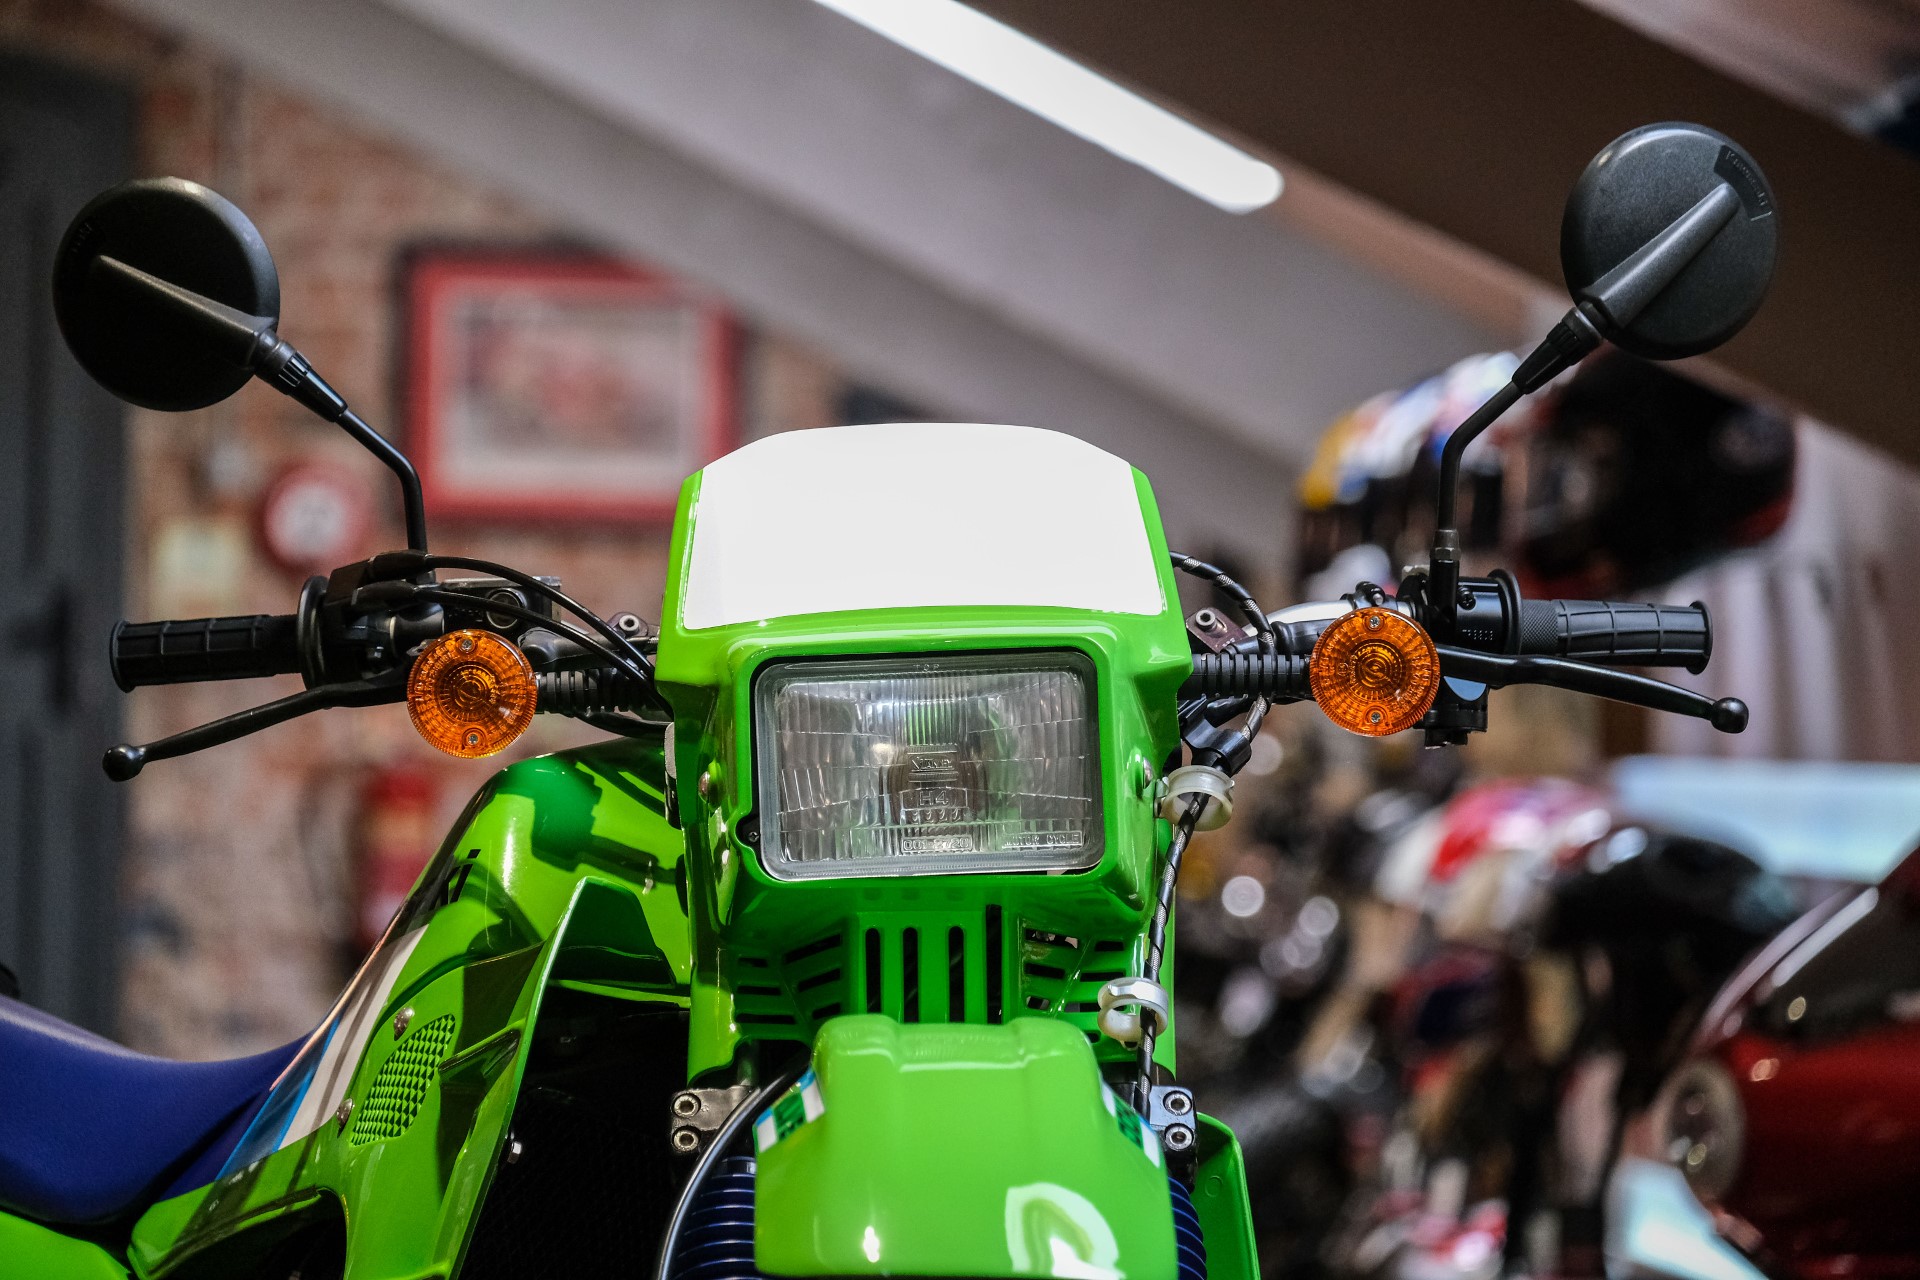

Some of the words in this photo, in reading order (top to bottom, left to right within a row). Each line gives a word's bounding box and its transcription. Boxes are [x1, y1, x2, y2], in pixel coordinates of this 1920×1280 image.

[912, 663, 940, 671] TOP
[919, 790, 949, 806] H4
[1046, 833, 1080, 845] CYCLE
